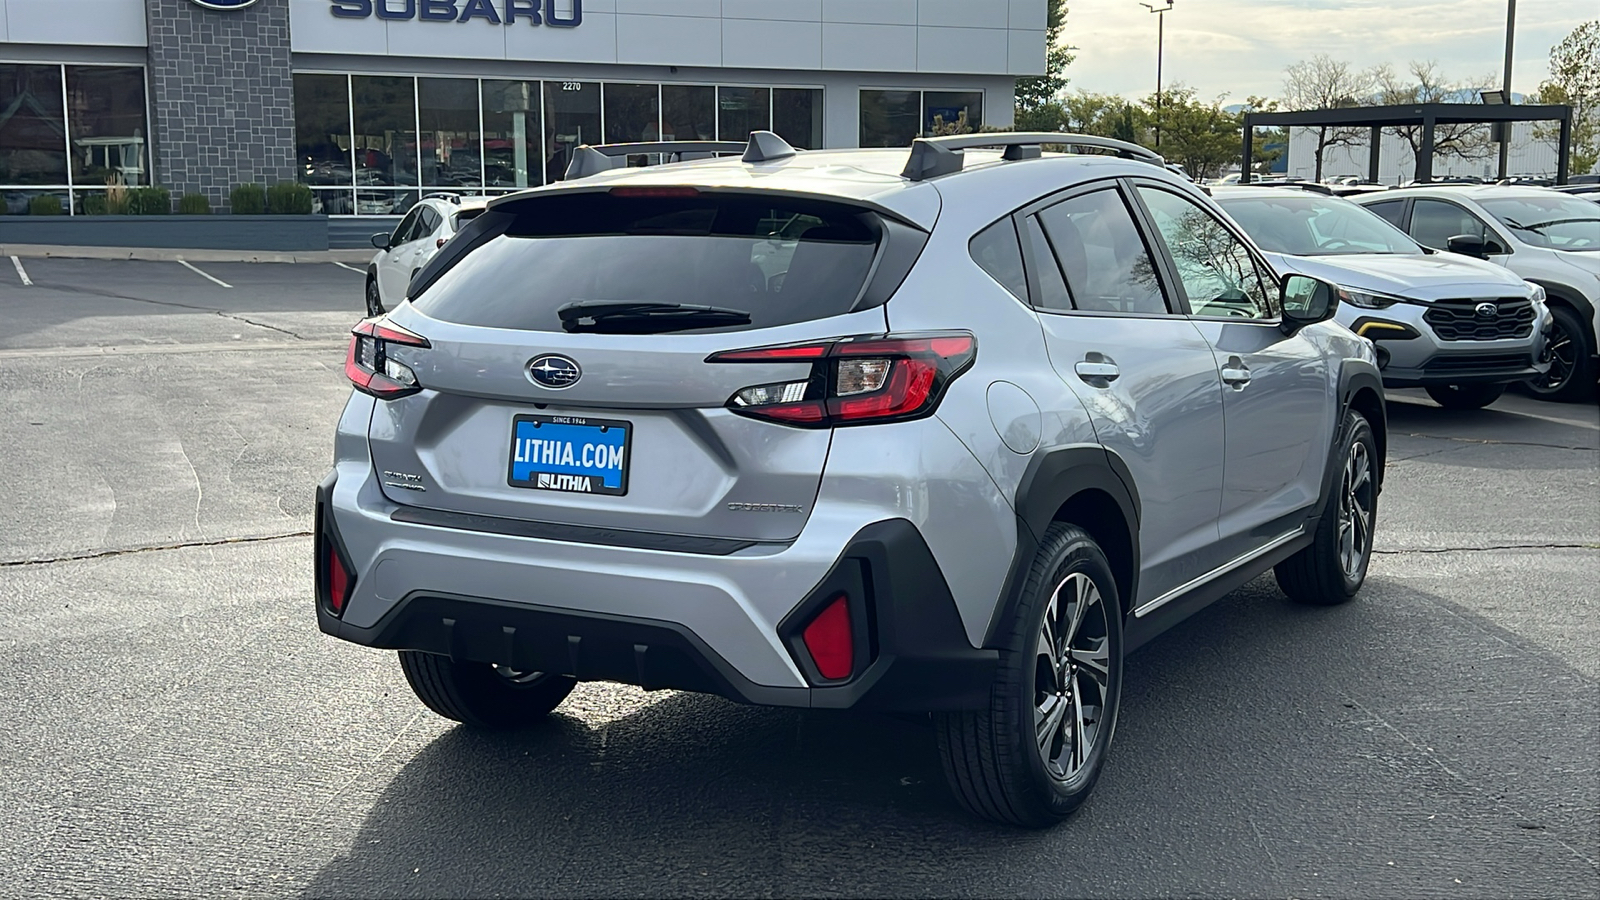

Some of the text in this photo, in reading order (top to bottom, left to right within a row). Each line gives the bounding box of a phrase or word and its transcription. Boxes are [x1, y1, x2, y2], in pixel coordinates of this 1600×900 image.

[562, 81, 582, 91] 2270
[552, 416, 586, 425] SINCE 1946
[514, 438, 624, 471] LITHIA.COM
[549, 473, 592, 492] LITHIA
[727, 502, 803, 514] CROSSTREK
